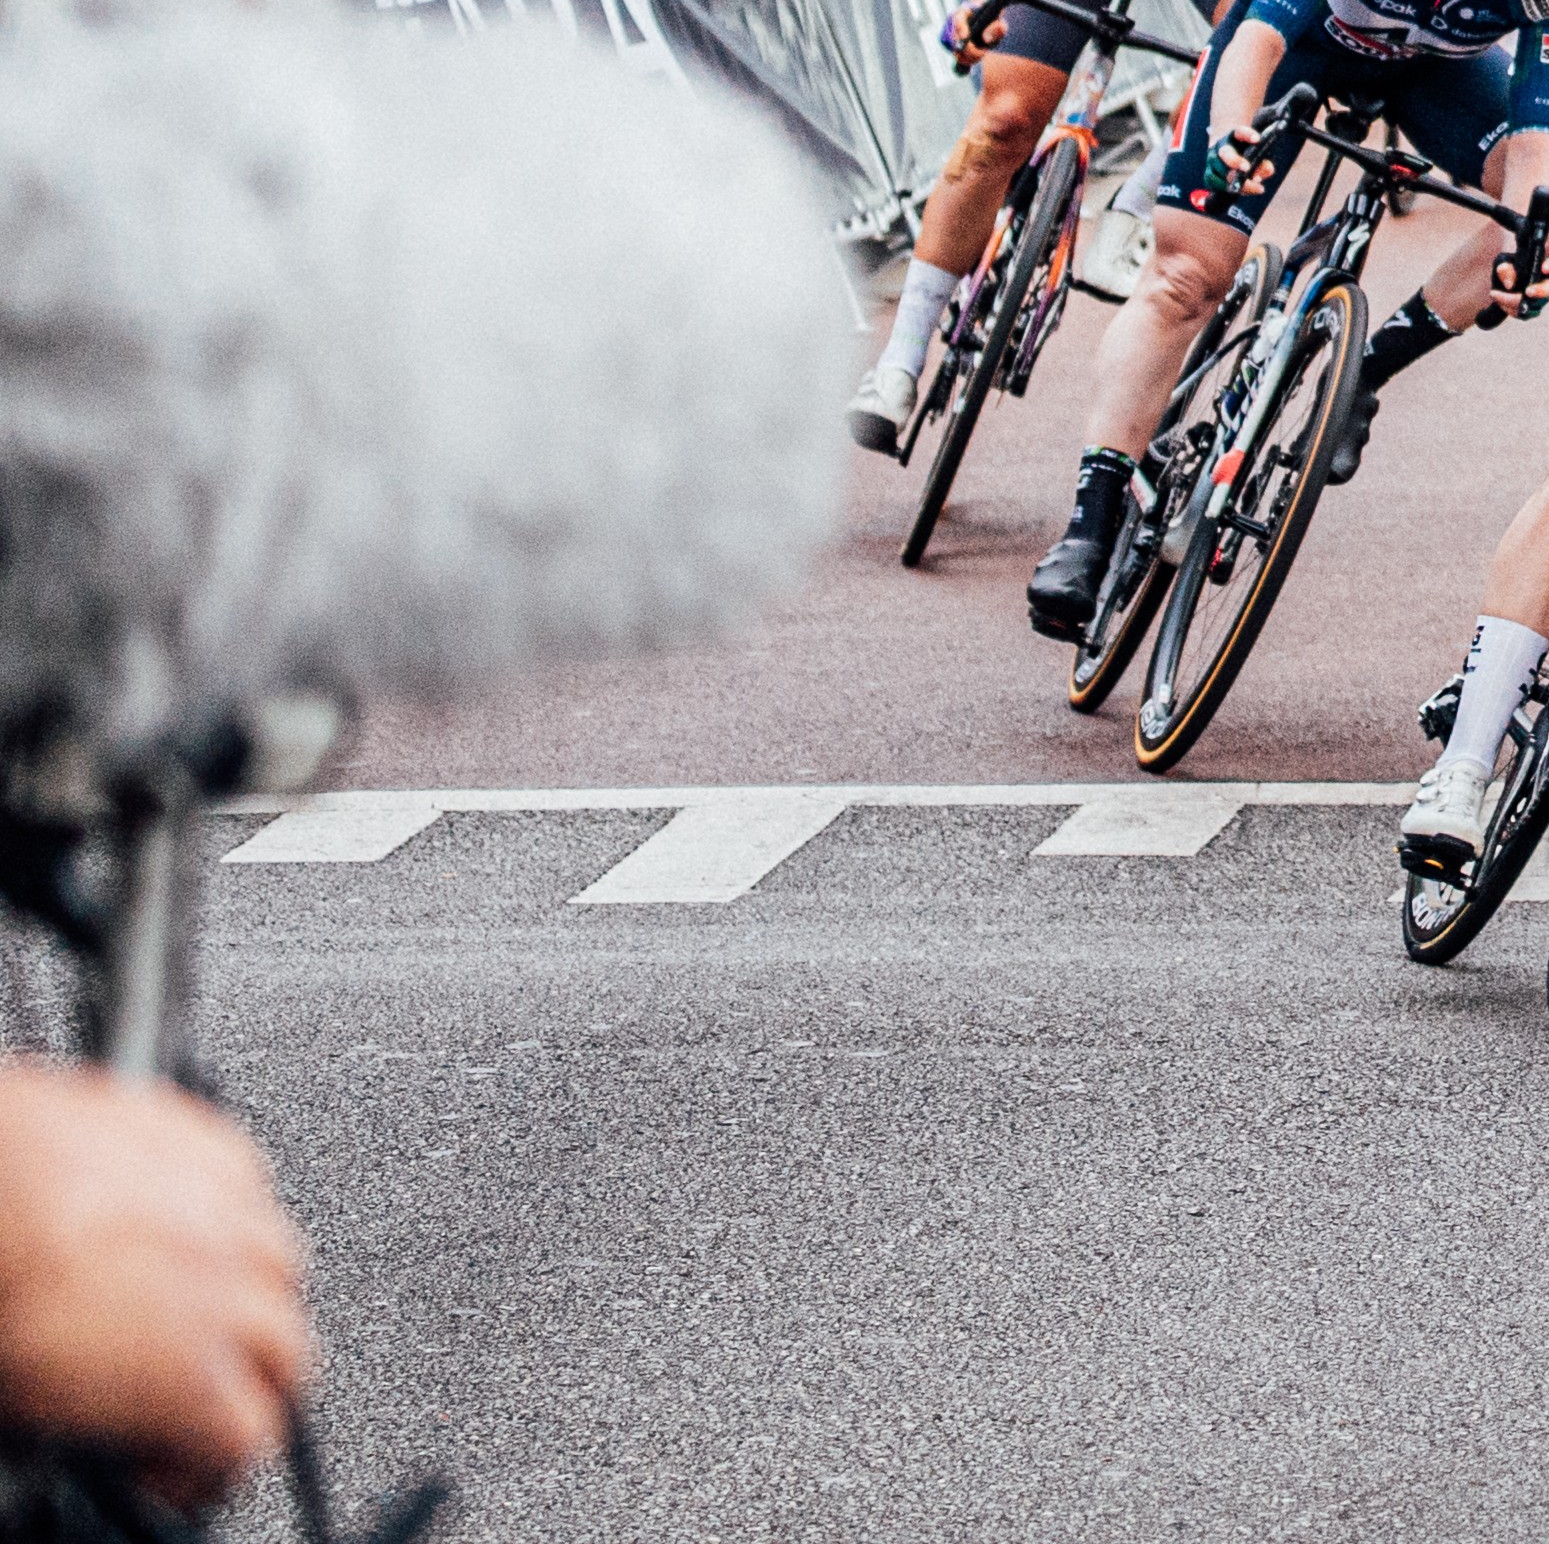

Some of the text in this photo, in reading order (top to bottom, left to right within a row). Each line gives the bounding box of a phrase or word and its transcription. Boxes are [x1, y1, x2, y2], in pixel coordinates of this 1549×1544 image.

[1478, 121, 1510, 152] Eko
[1156, 184, 1181, 199] pak
[1227, 205, 1257, 231] Ekop
